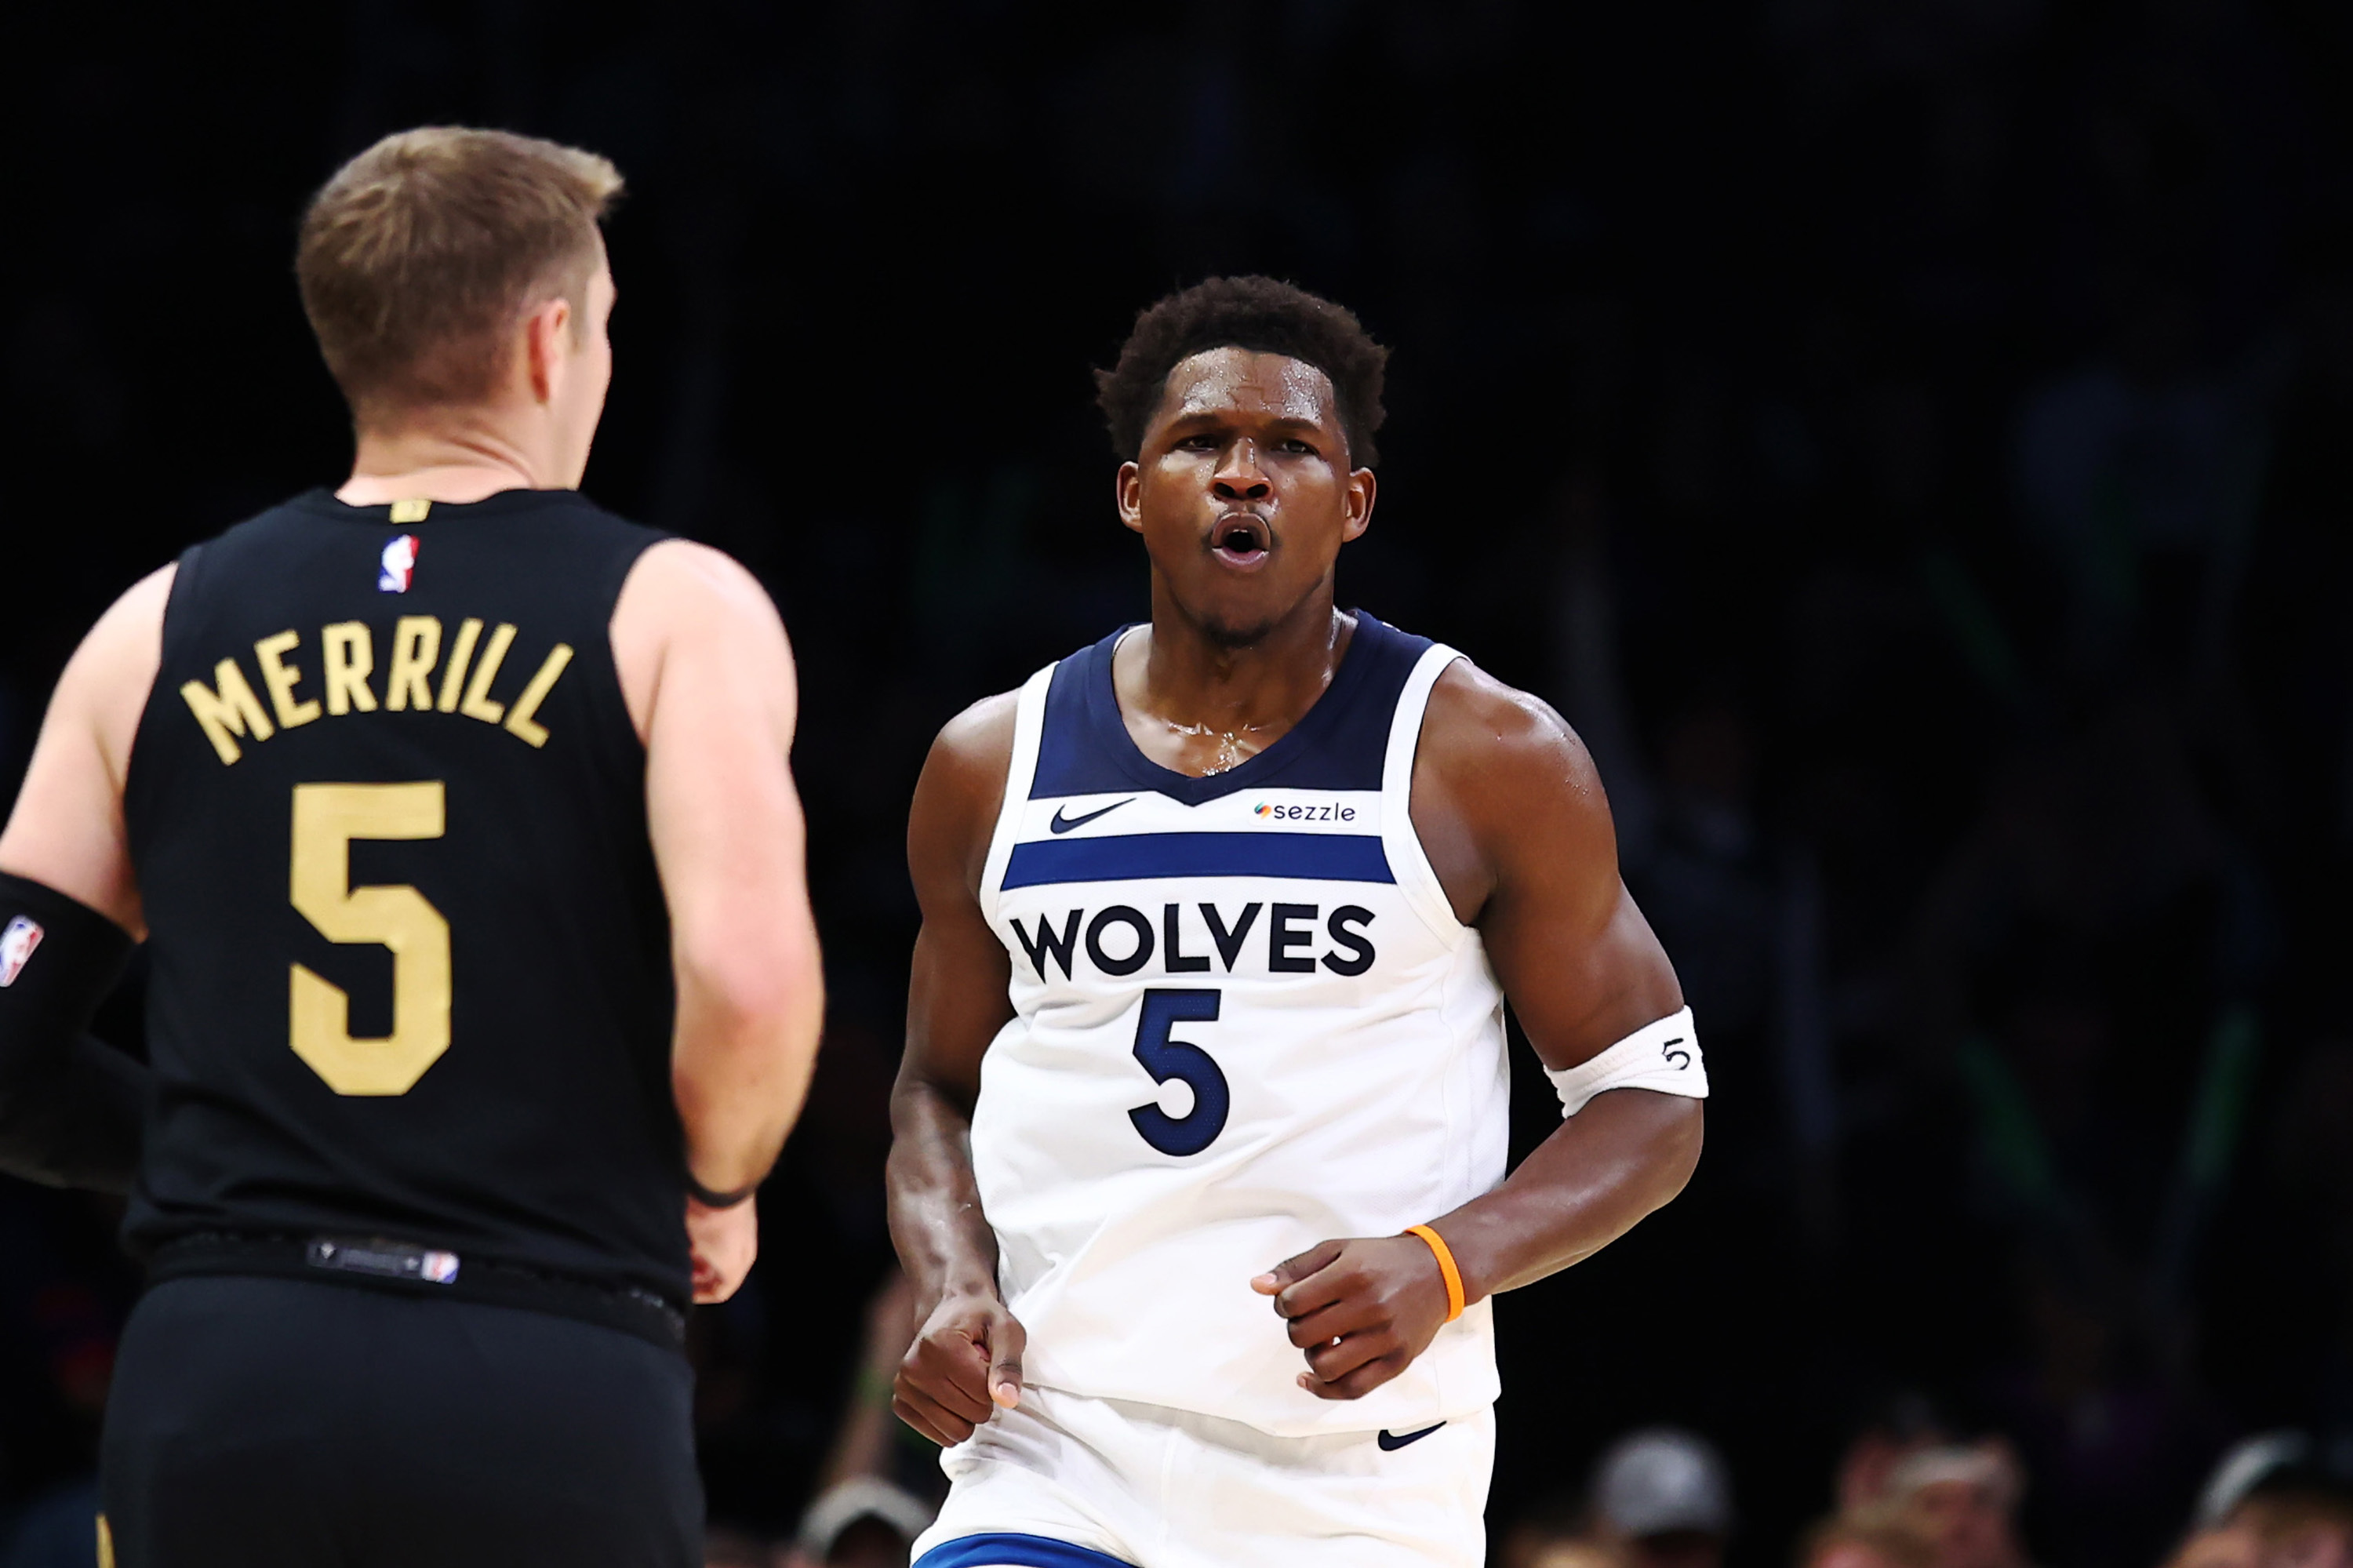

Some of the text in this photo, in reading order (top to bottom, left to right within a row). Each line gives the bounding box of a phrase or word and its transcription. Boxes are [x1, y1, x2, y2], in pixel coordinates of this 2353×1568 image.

[180, 615, 573, 766] MERRILL
[1274, 802, 1356, 821] sezzle
[289, 780, 453, 1097] 5
[1009, 902, 1376, 984] WOLVES
[1127, 988, 1231, 1158] 5
[1662, 1037, 1691, 1071] 5
